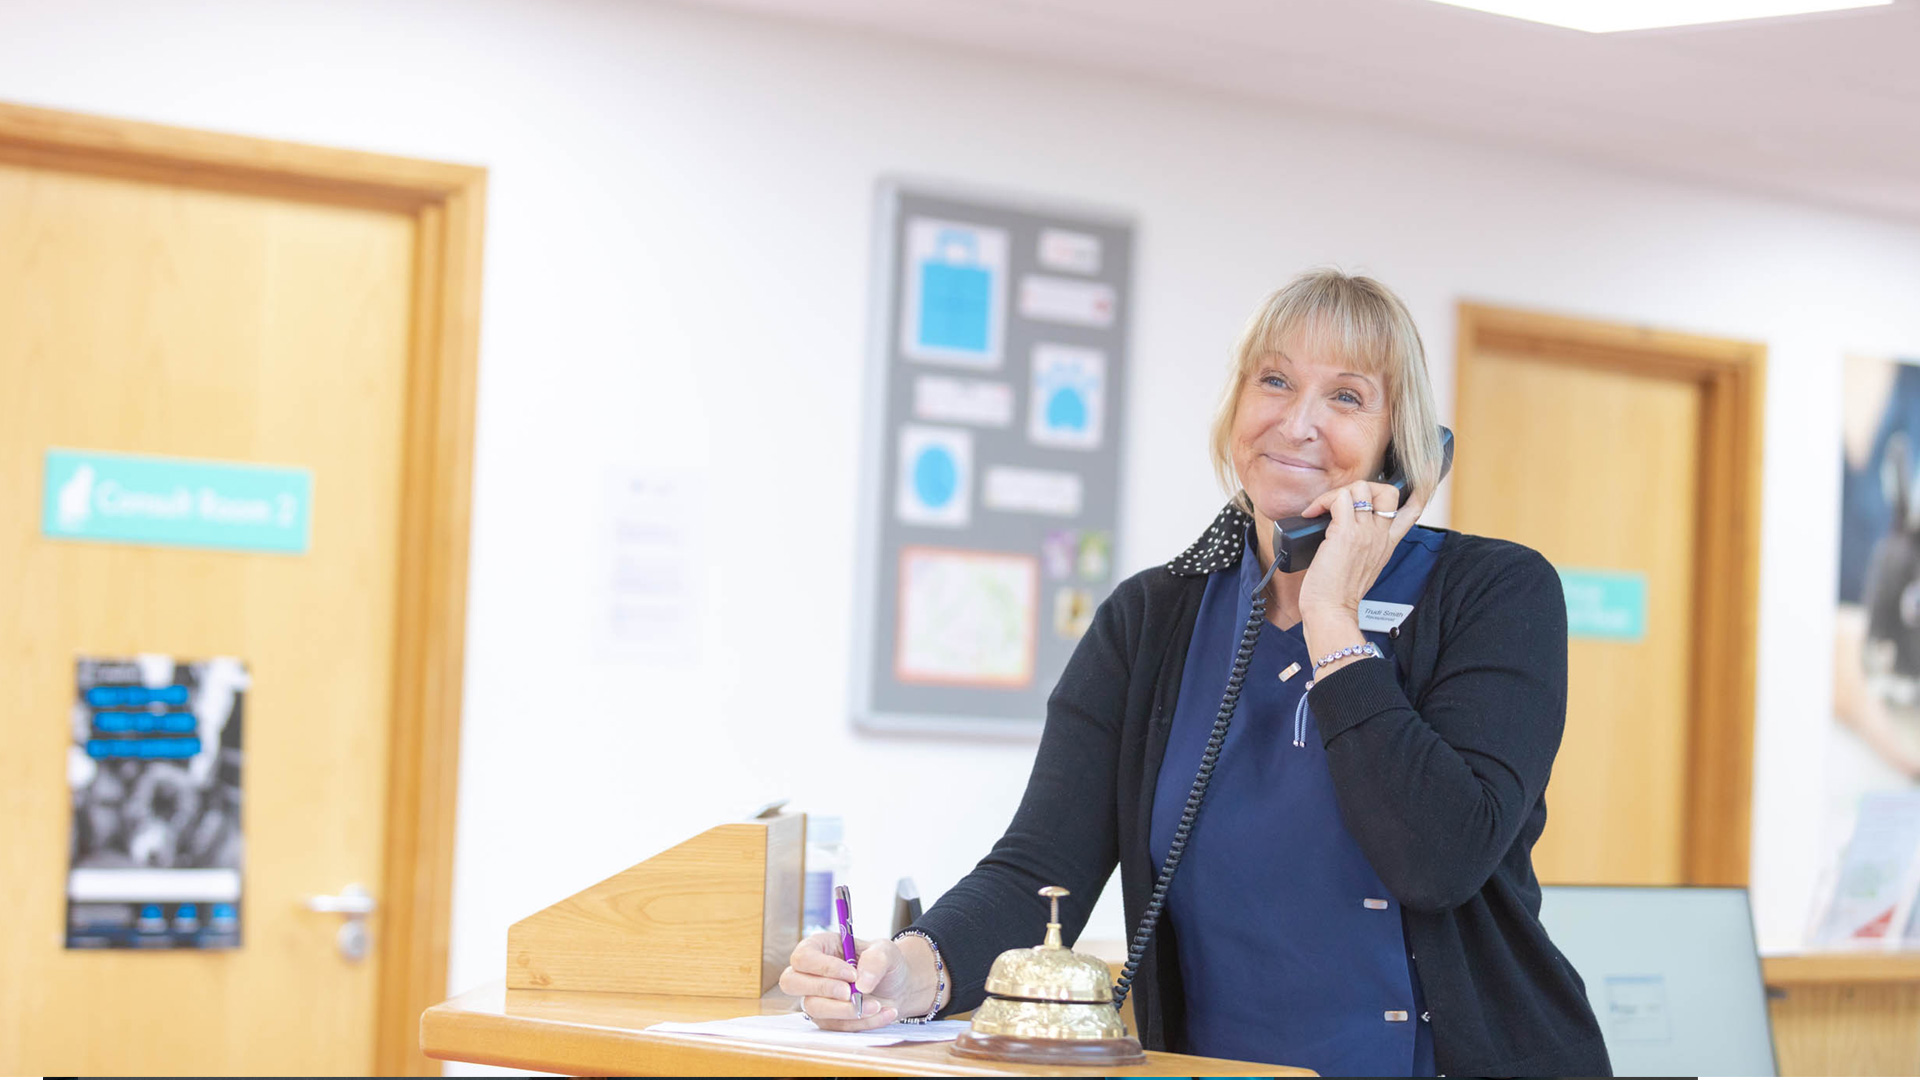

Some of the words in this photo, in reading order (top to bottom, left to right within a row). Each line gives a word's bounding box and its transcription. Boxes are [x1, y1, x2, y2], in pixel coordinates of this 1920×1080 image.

[96, 479, 192, 518] Consult
[198, 486, 272, 525] Room
[1383, 610, 1404, 618] Smith
